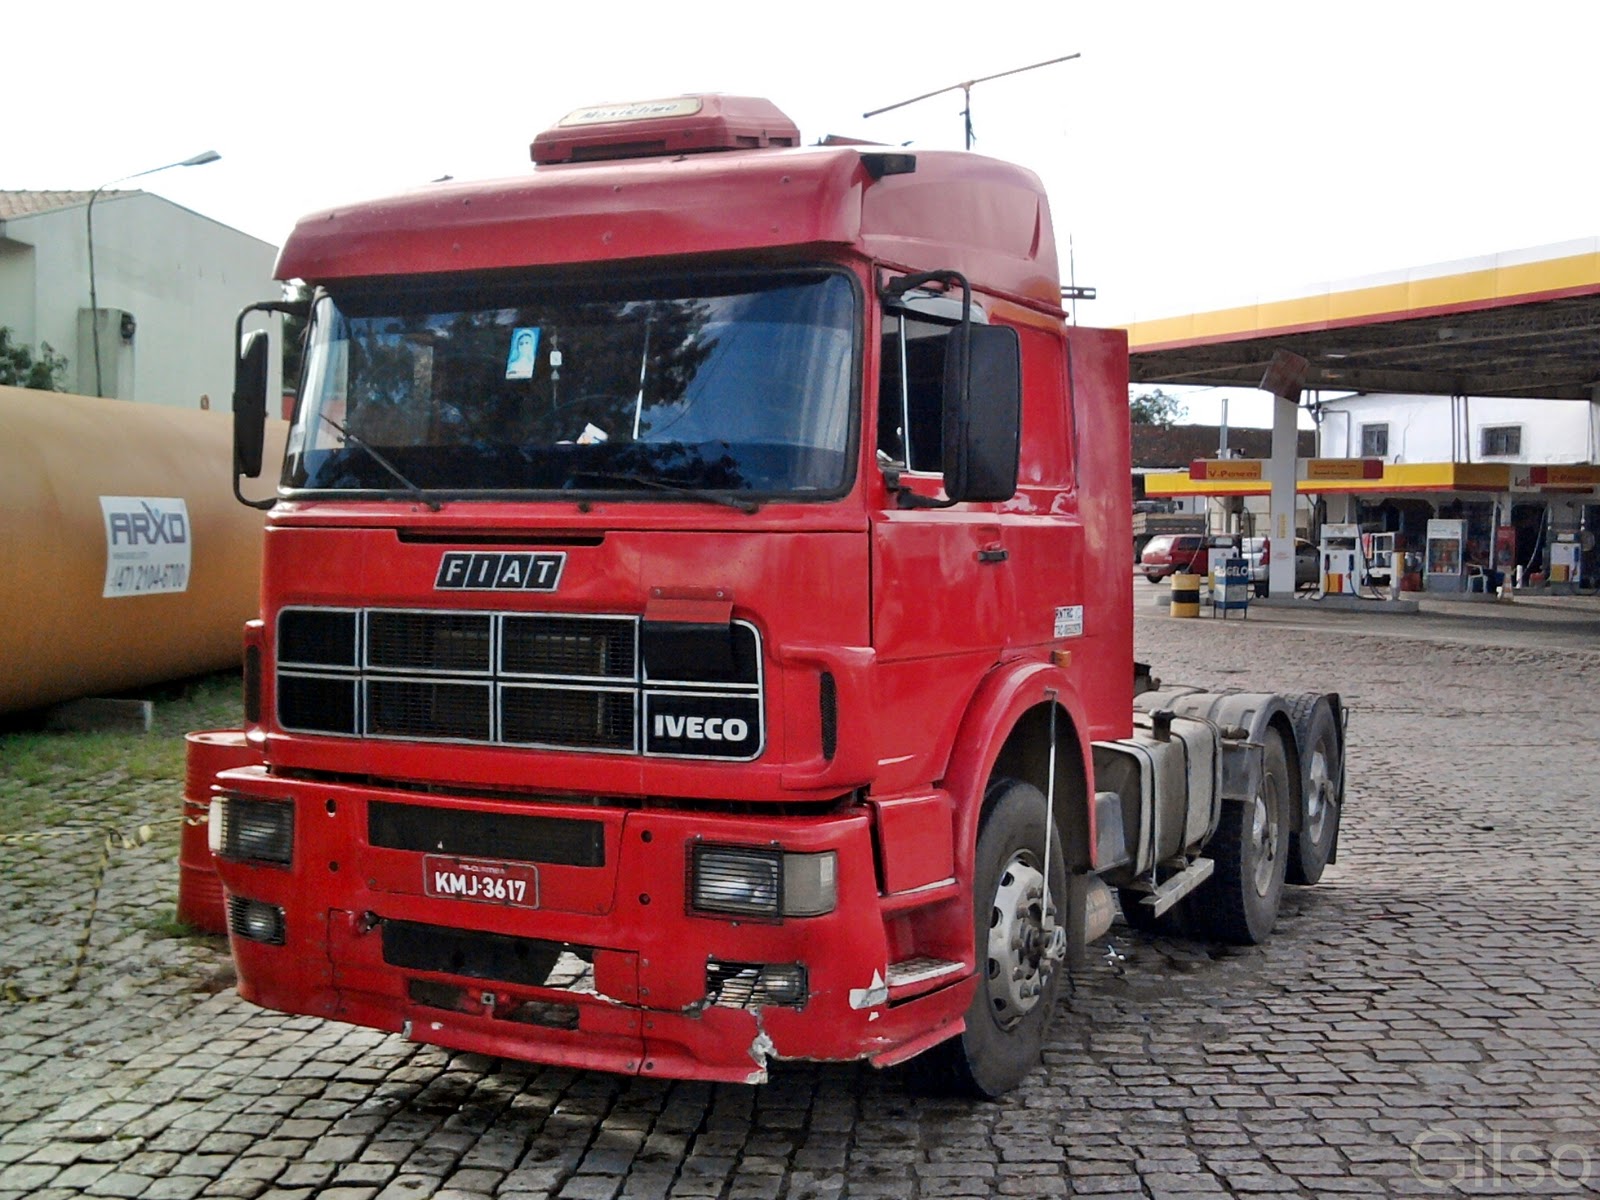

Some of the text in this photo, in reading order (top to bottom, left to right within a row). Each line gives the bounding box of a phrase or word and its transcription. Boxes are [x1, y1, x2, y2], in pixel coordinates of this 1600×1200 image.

[110, 501, 186, 545] ARXO
[445, 559, 555, 584] FIAT
[654, 714, 748, 742] IVECO
